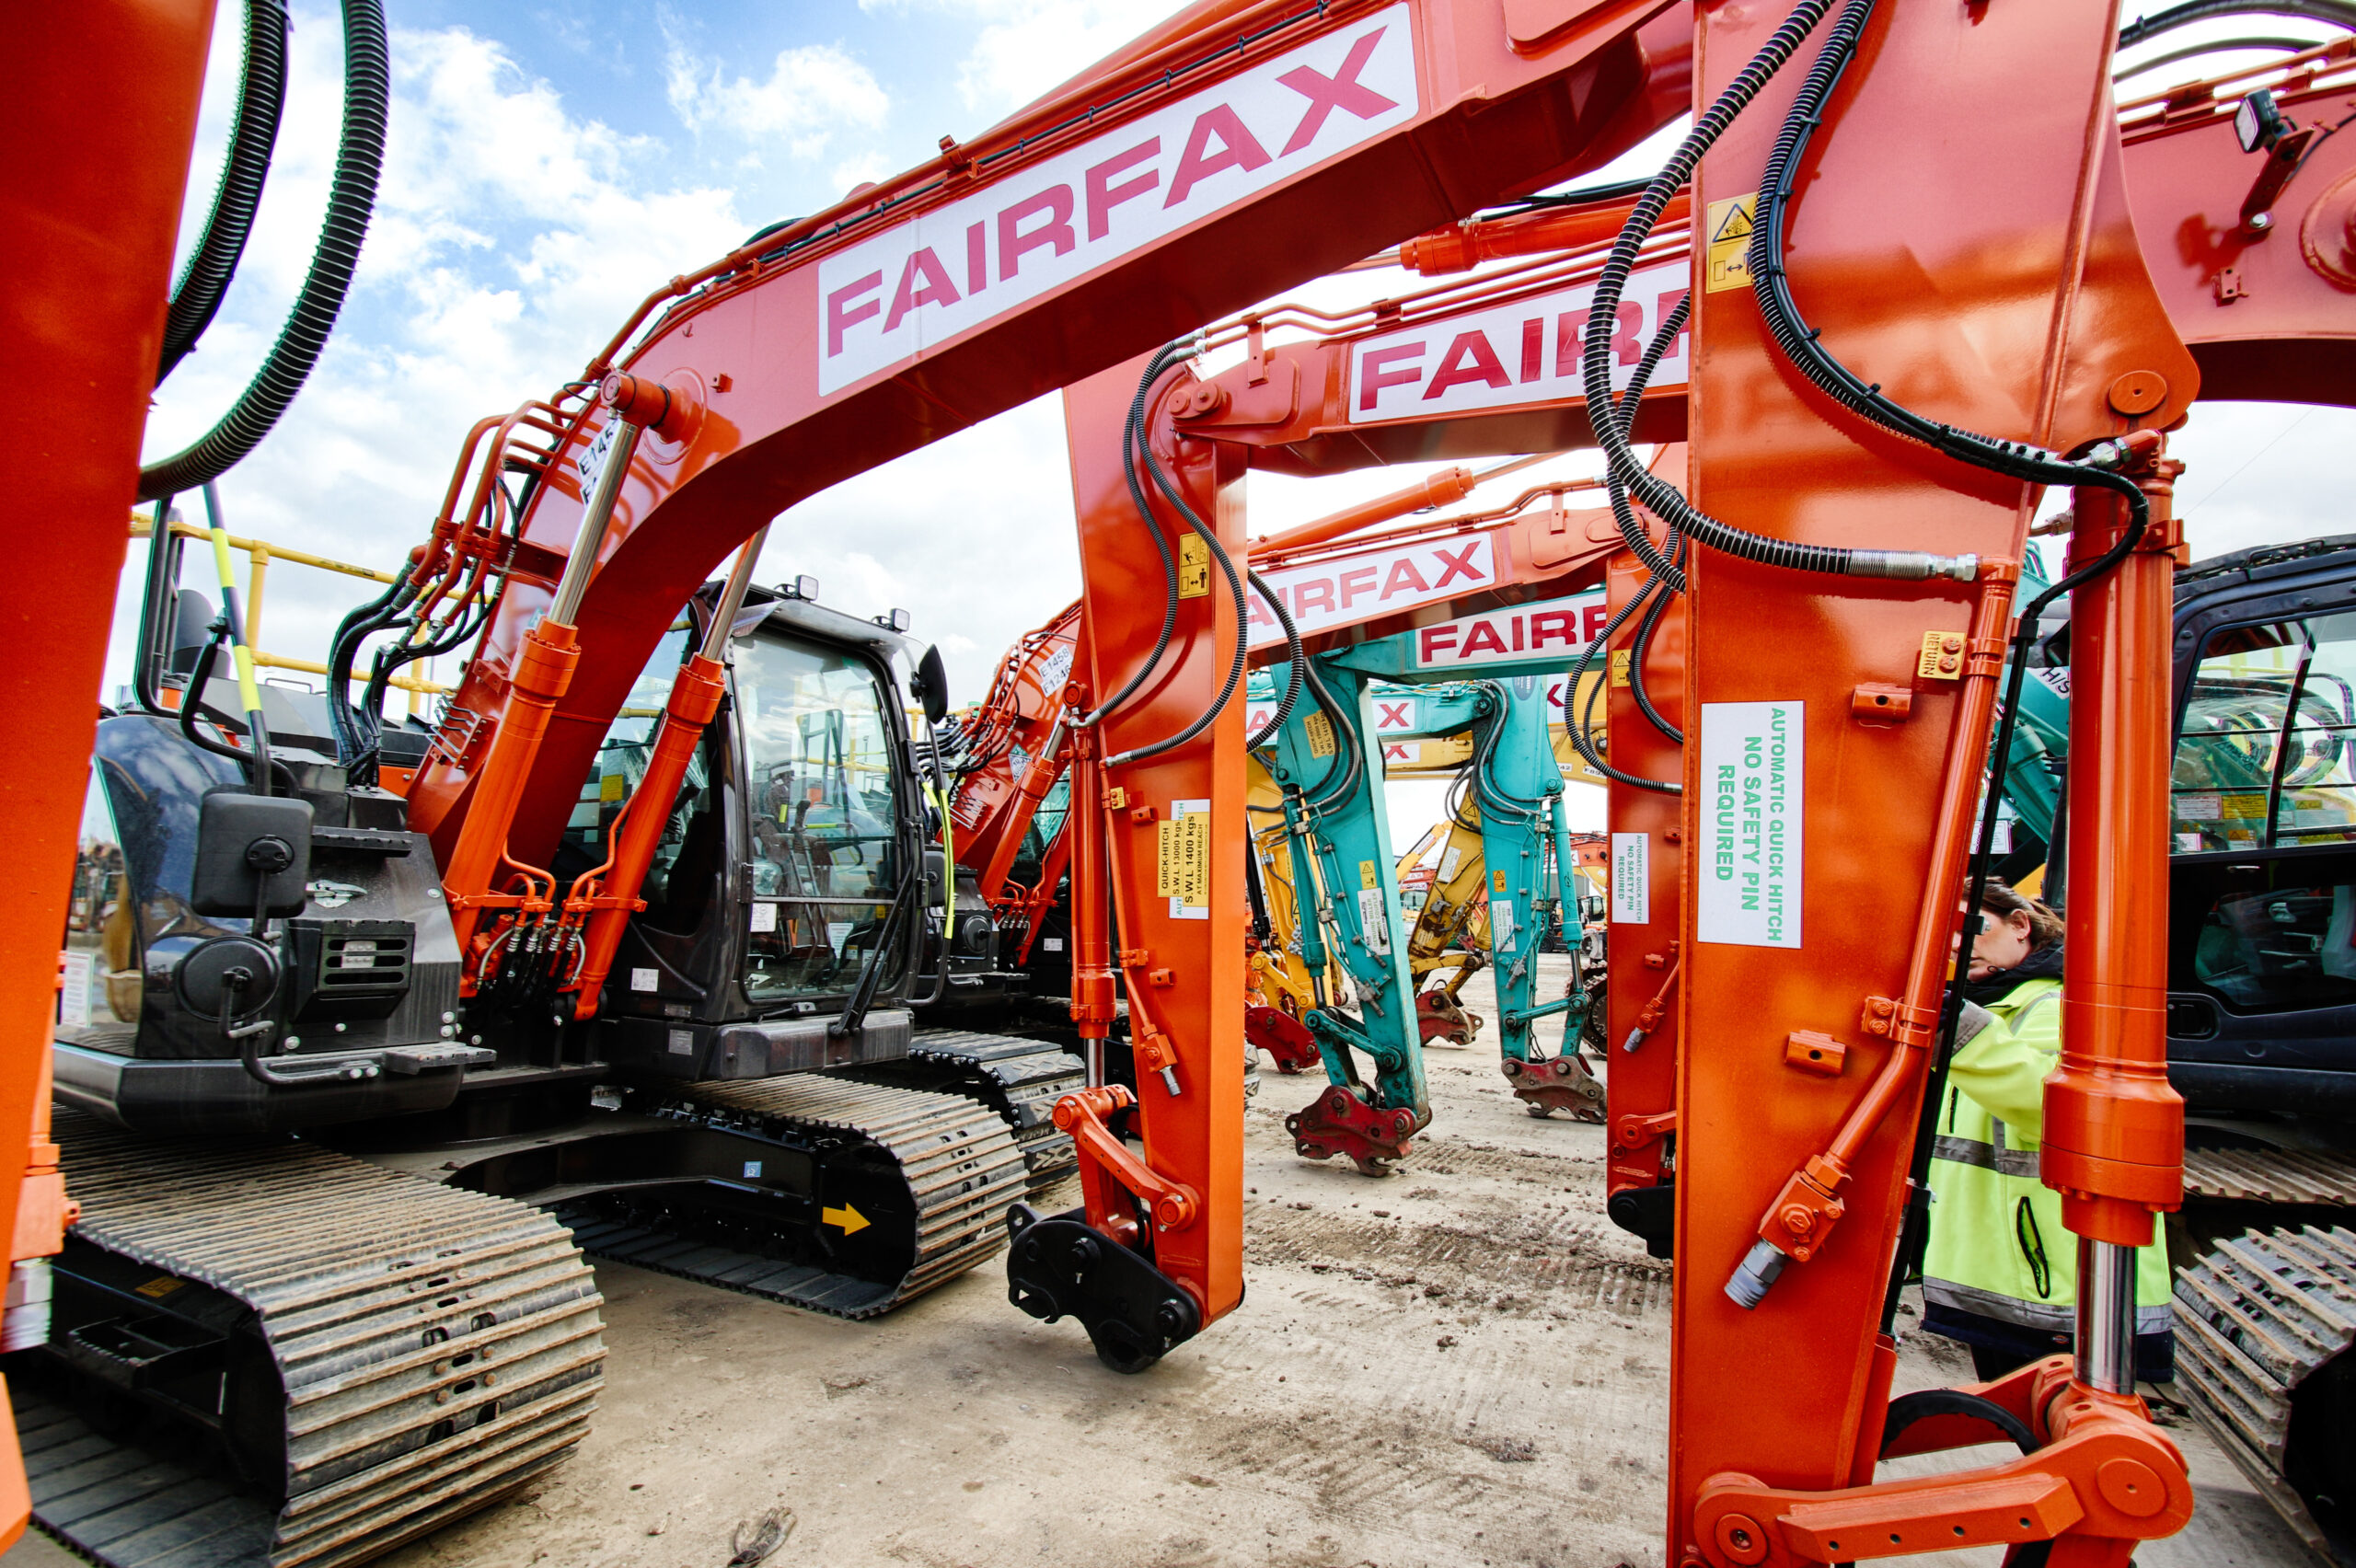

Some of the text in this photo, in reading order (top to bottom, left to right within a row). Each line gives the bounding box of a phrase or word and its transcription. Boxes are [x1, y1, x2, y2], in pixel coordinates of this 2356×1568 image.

[827, 26, 1400, 359] FAIRFAX
[1041, 648, 1069, 677] E1458
[1923, 633, 1940, 675] RETURN
[1173, 822, 1183, 837] kgs
[1185, 815, 1196, 836] kgs
[1715, 765, 1736, 881] REQUIRED
[1741, 736, 1761, 911] NO SAFETY PIN
[1767, 707, 1785, 941] AUTOMATIC QUICK HITCH
[1185, 839, 1194, 865] 1400
[1627, 845, 1634, 858] NO
